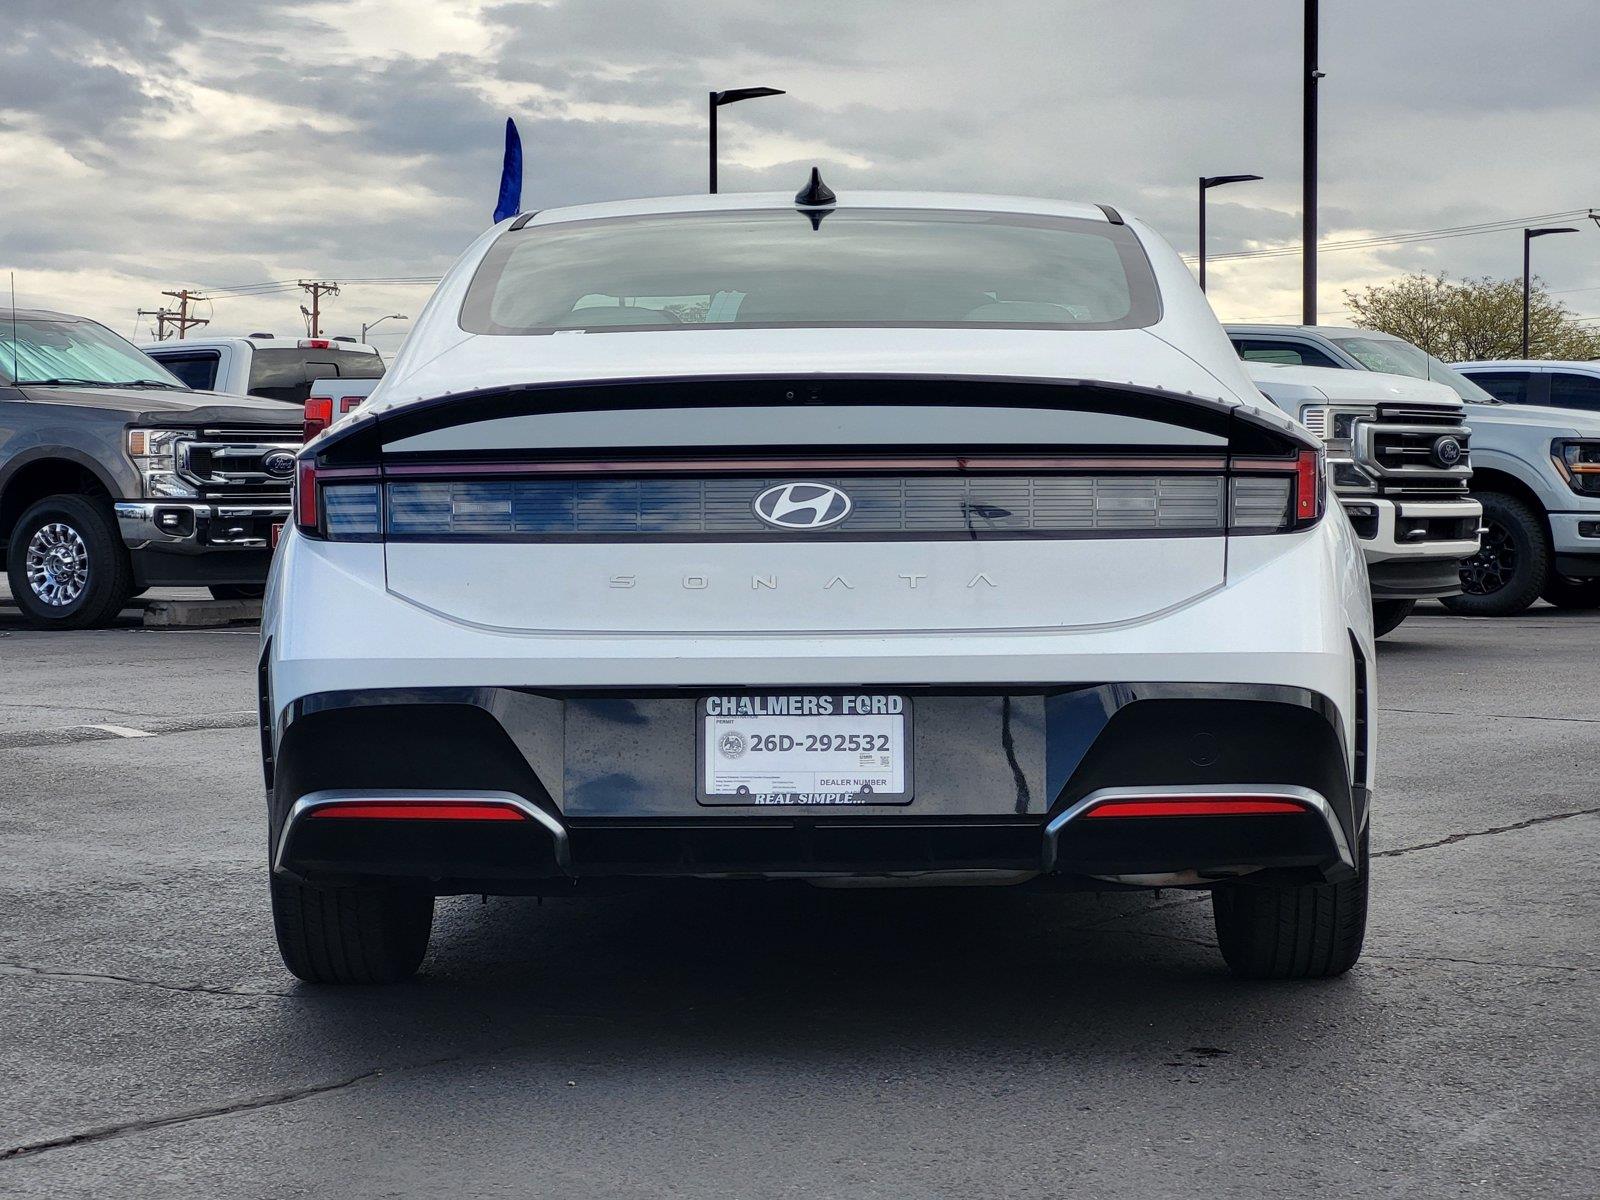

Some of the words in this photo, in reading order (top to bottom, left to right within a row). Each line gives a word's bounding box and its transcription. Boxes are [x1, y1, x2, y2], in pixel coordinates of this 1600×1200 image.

[274, 457, 293, 469] Ford
[609, 573, 997, 590] SONATA
[706, 696, 833, 716] CHALMERS
[843, 695, 903, 715] FORD
[750, 734, 890, 752] 26D-292532
[754, 793, 794, 804] REAL
[798, 793, 866, 805] SIMPLE...
